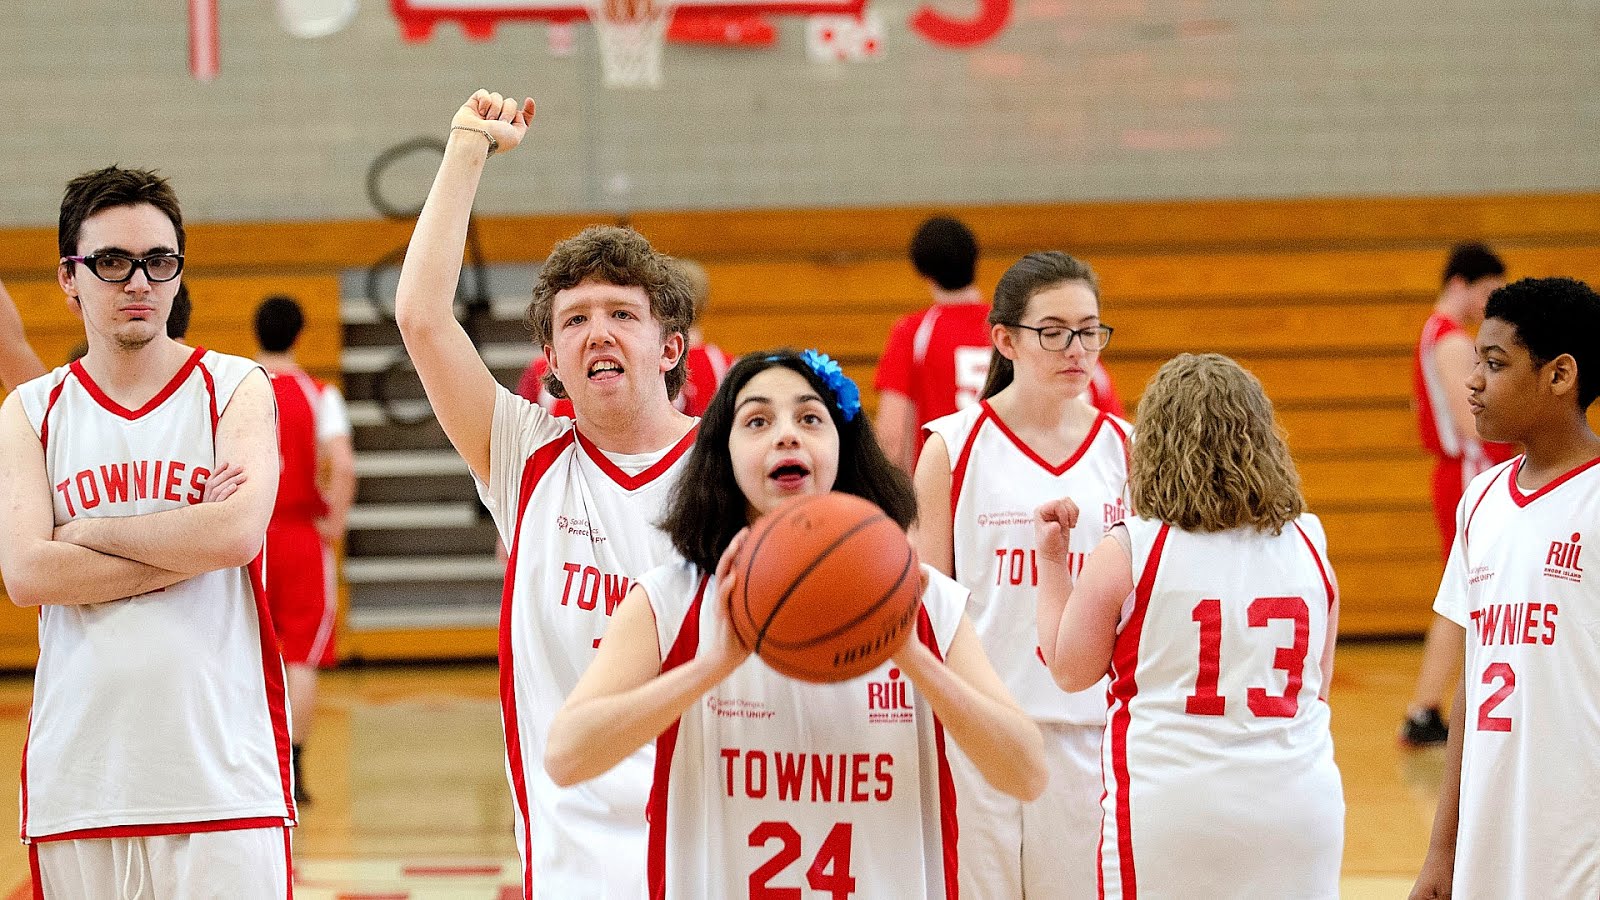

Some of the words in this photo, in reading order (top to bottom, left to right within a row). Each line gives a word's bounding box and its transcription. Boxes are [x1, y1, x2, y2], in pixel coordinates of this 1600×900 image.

[56, 460, 211, 518] TOWNIES
[568, 527, 588, 536] Prect
[561, 562, 629, 616] TOW
[1185, 597, 1309, 718] 13
[717, 708, 744, 718] Project
[1477, 662, 1516, 732] 2
[720, 748, 893, 802] TOWNIES
[748, 821, 856, 900] 24
